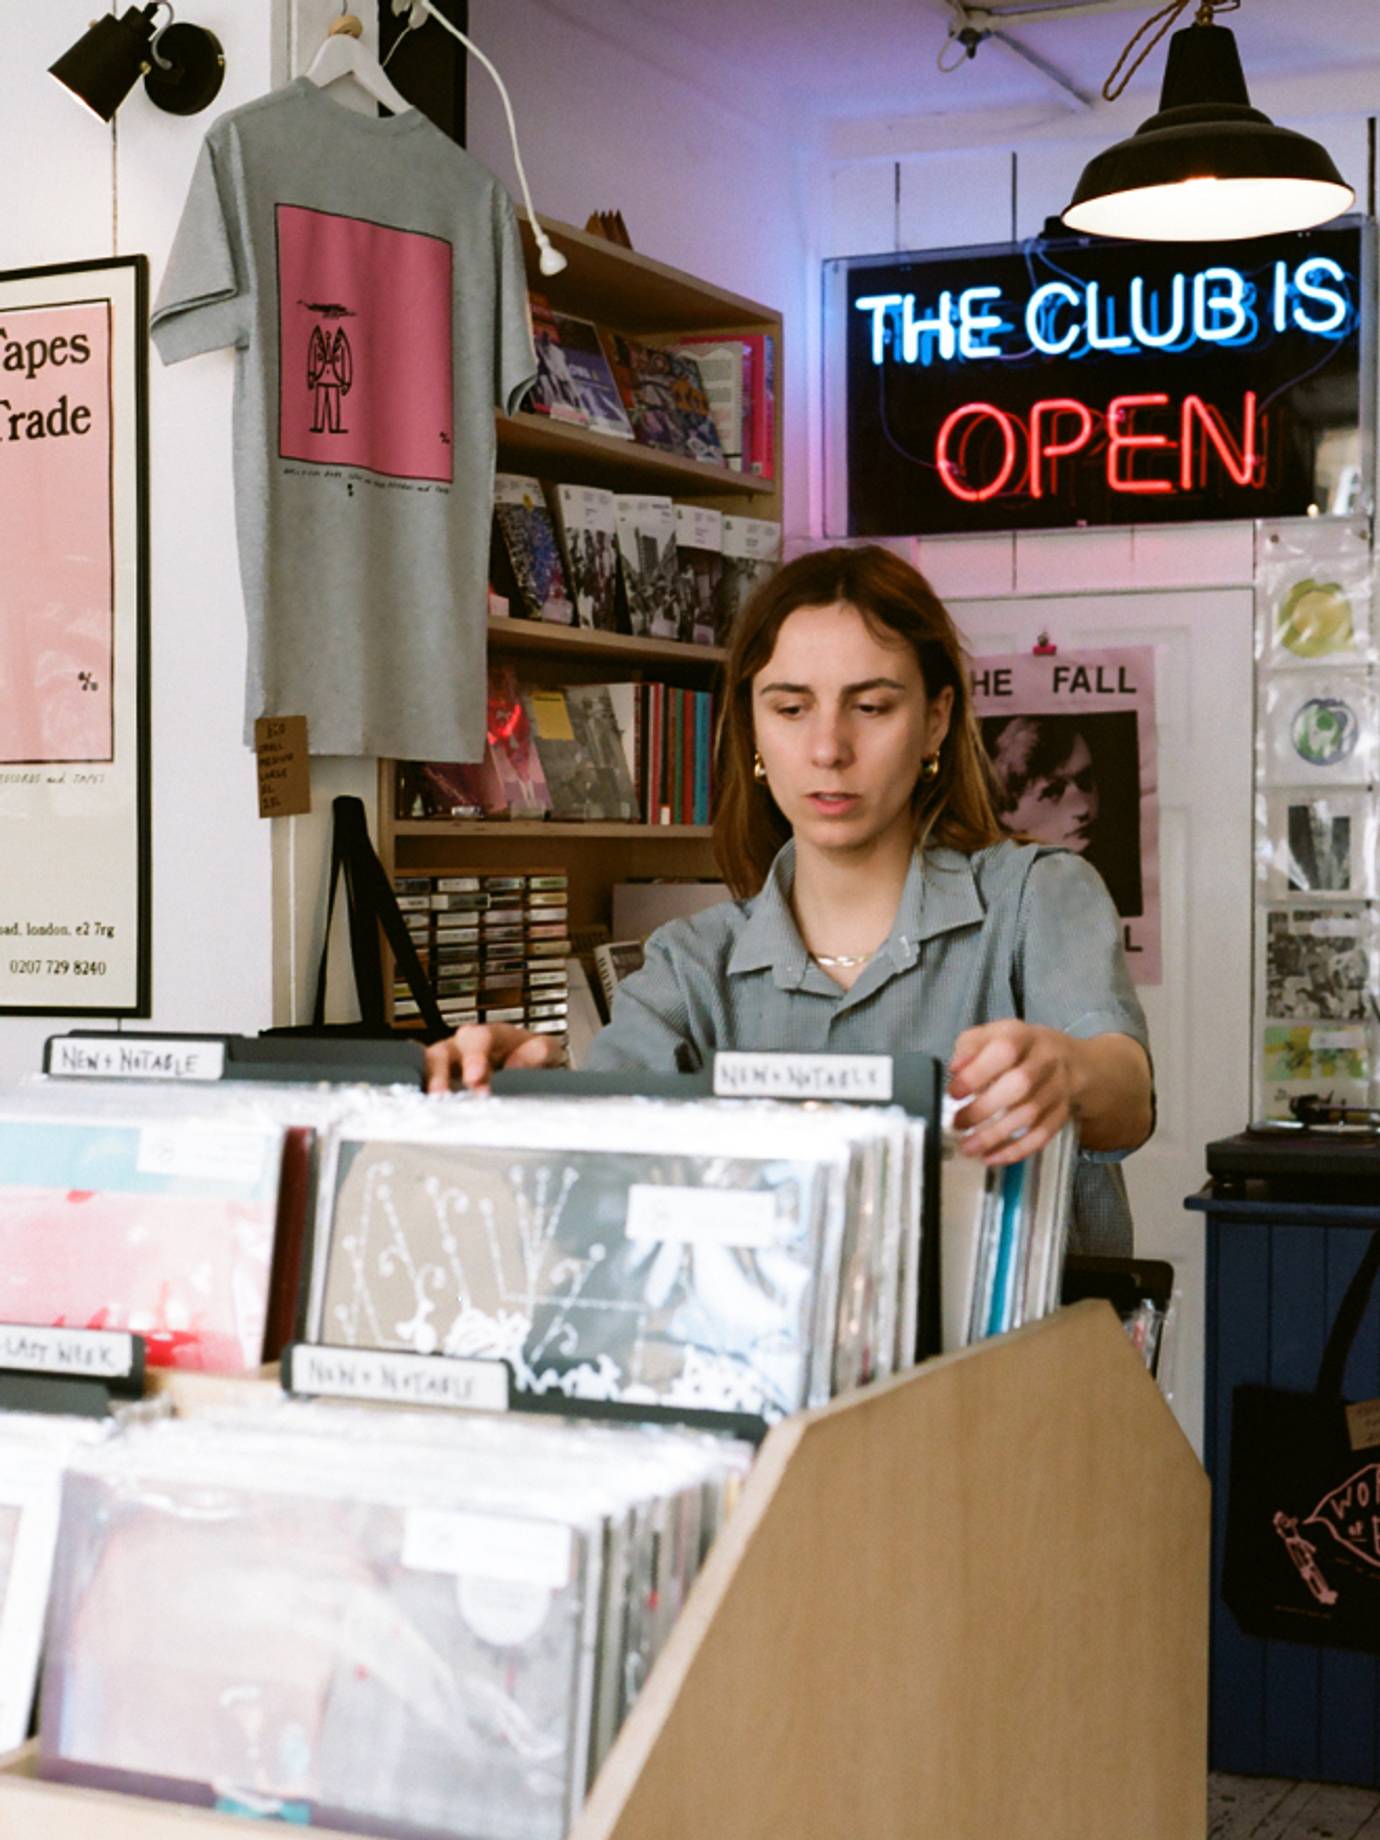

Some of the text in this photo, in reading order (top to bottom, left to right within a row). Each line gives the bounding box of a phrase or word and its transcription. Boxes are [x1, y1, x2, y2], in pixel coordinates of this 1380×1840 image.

[856, 257, 1347, 365] THE CLUB IS
[0, 327, 91, 379] apes
[935, 390, 1257, 502] OPEN
[971, 665, 1137, 697] HE FALL
[75, 921, 91, 937] e2
[94, 921, 115, 939] 7rg
[10, 959, 107, 976] 0207 729 8240
